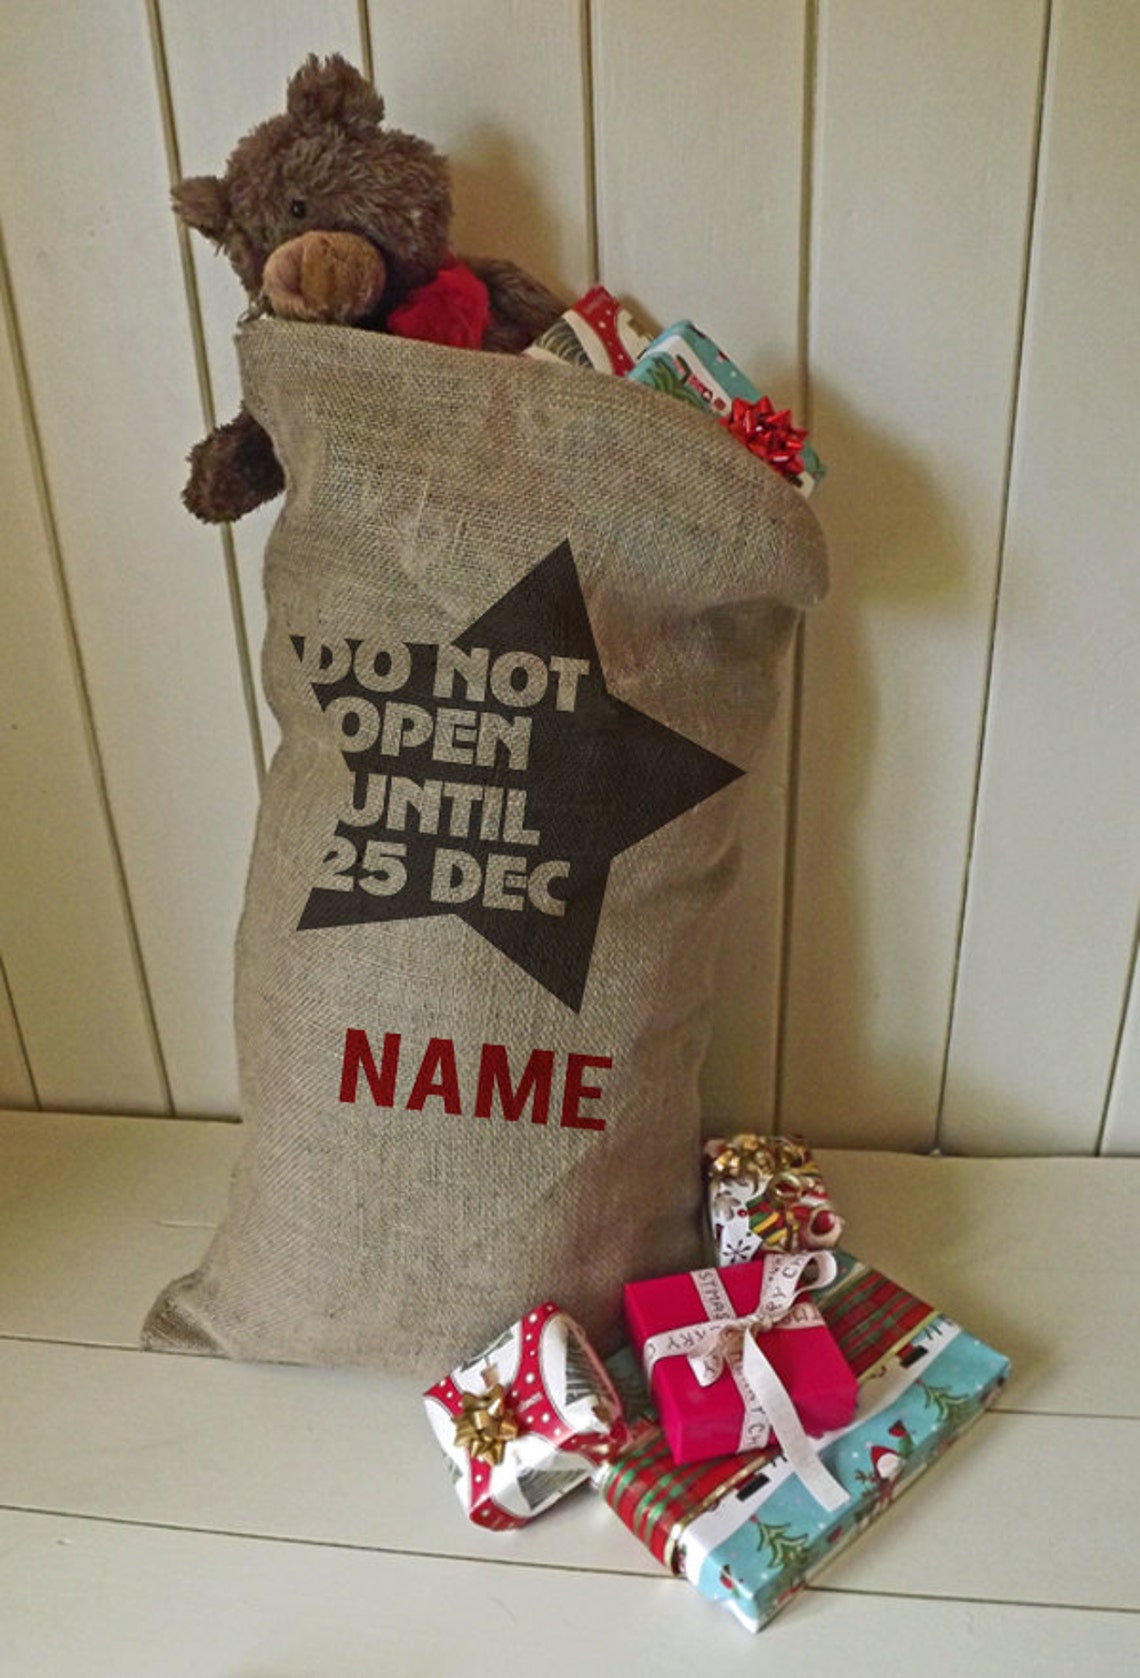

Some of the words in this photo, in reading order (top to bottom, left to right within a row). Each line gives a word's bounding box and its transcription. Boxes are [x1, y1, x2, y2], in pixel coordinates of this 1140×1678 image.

[300, 636, 412, 693] DO
[432, 643, 590, 712] NOT
[323, 696, 533, 770] OPEN
[336, 768, 541, 846] UNTIL
[306, 835, 408, 896] 25
[430, 848, 571, 917] DEC
[339, 1028, 613, 1131] NAME
